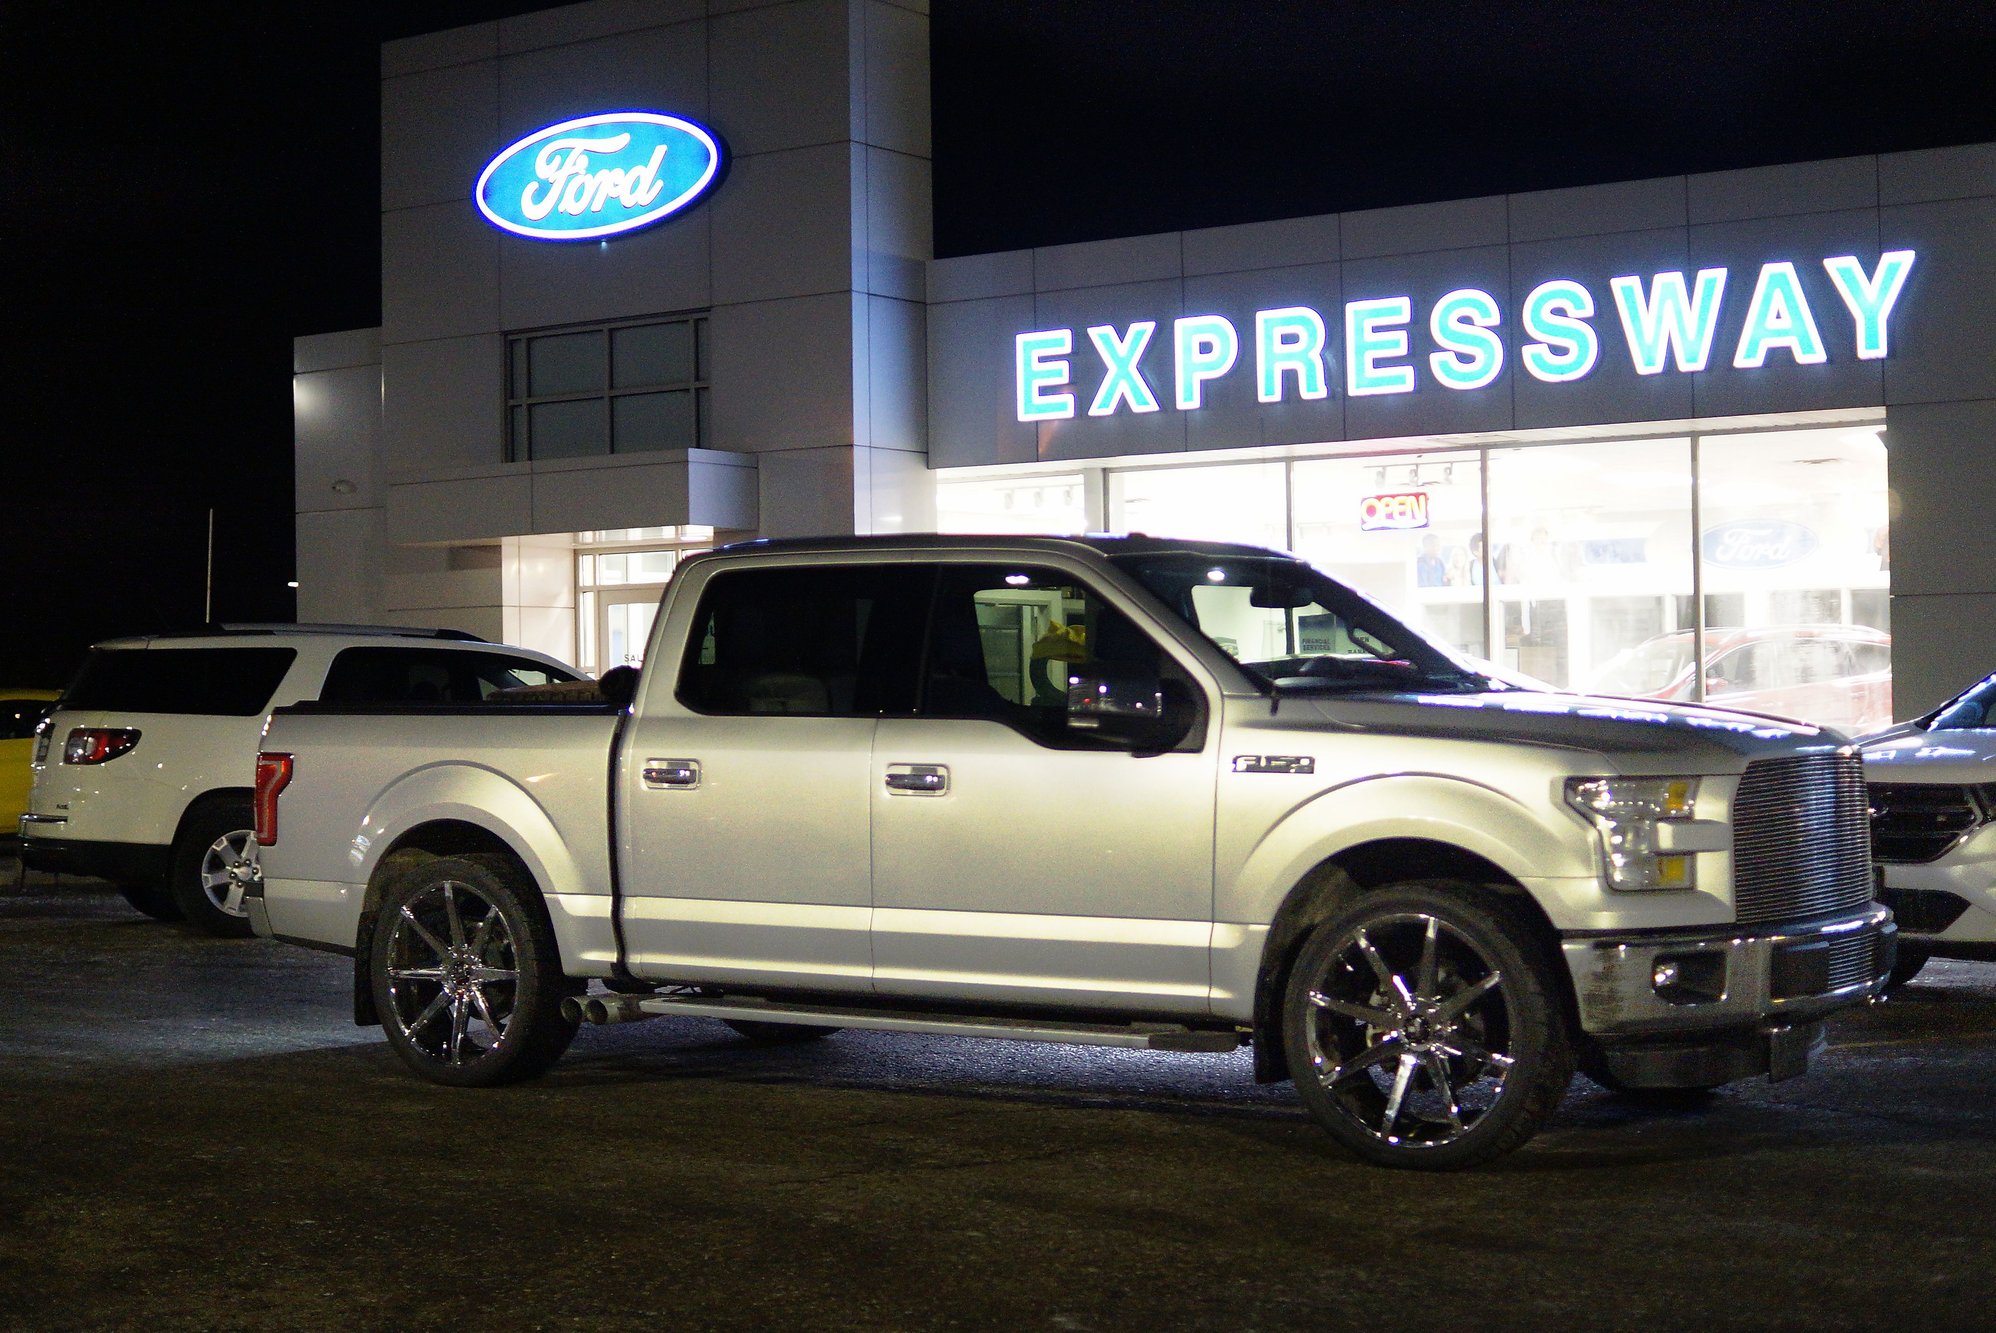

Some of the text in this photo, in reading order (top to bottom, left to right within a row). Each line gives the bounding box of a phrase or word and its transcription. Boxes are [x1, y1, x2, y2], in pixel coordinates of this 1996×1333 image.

[520, 132, 668, 221] Ford
[1014, 249, 1918, 423] EXPRESSWAY
[1361, 494, 1427, 523] OPEN
[1716, 528, 1792, 562] Ford
[624, 653, 643, 662] SAL
